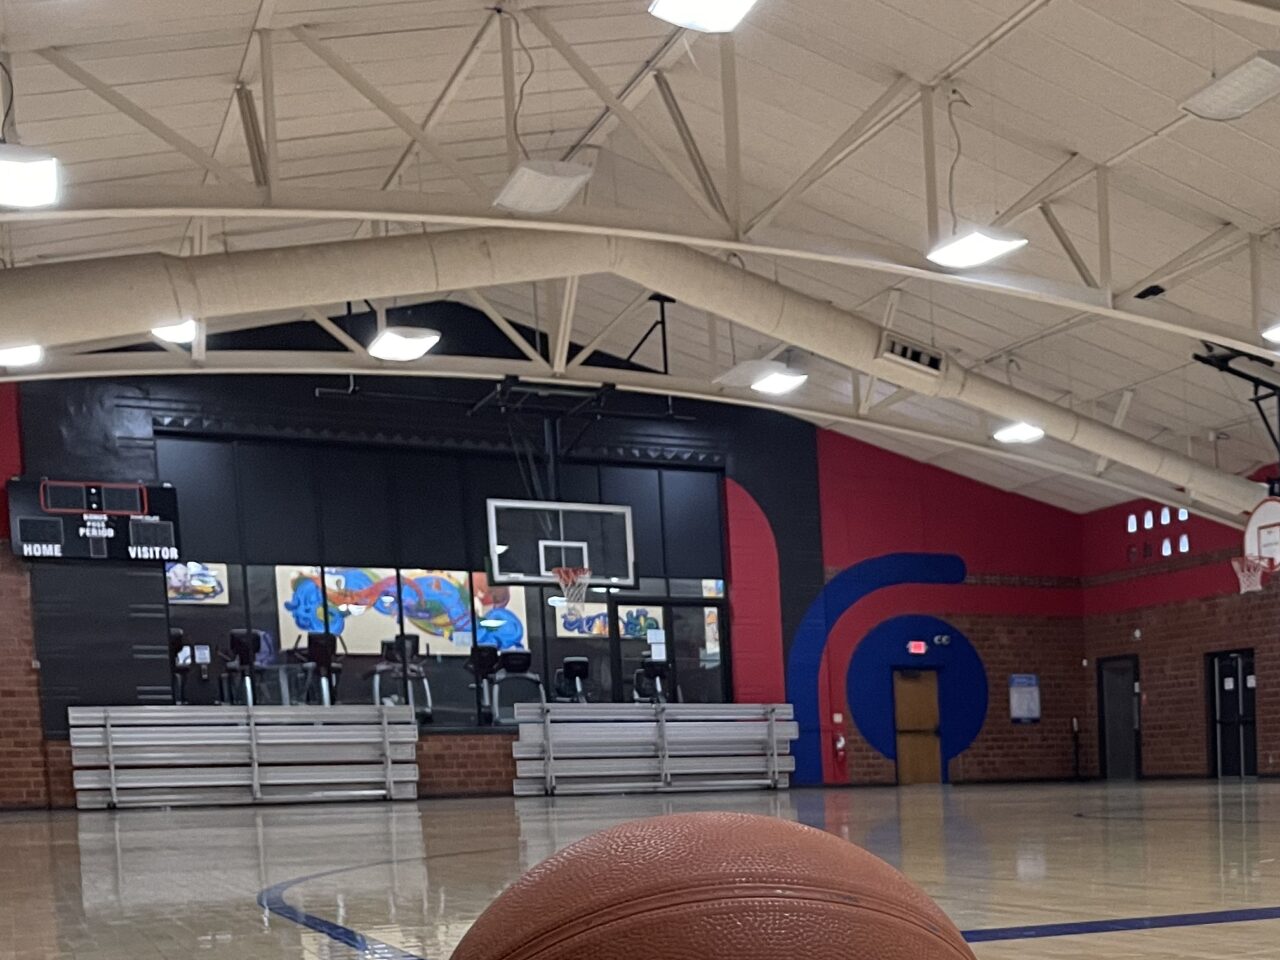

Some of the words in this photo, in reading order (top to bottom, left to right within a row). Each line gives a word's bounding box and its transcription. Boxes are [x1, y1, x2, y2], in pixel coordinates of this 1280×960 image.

[79, 527, 114, 538] PERIOD
[23, 544, 62, 557] HOME
[128, 546, 179, 560] VISITOR
